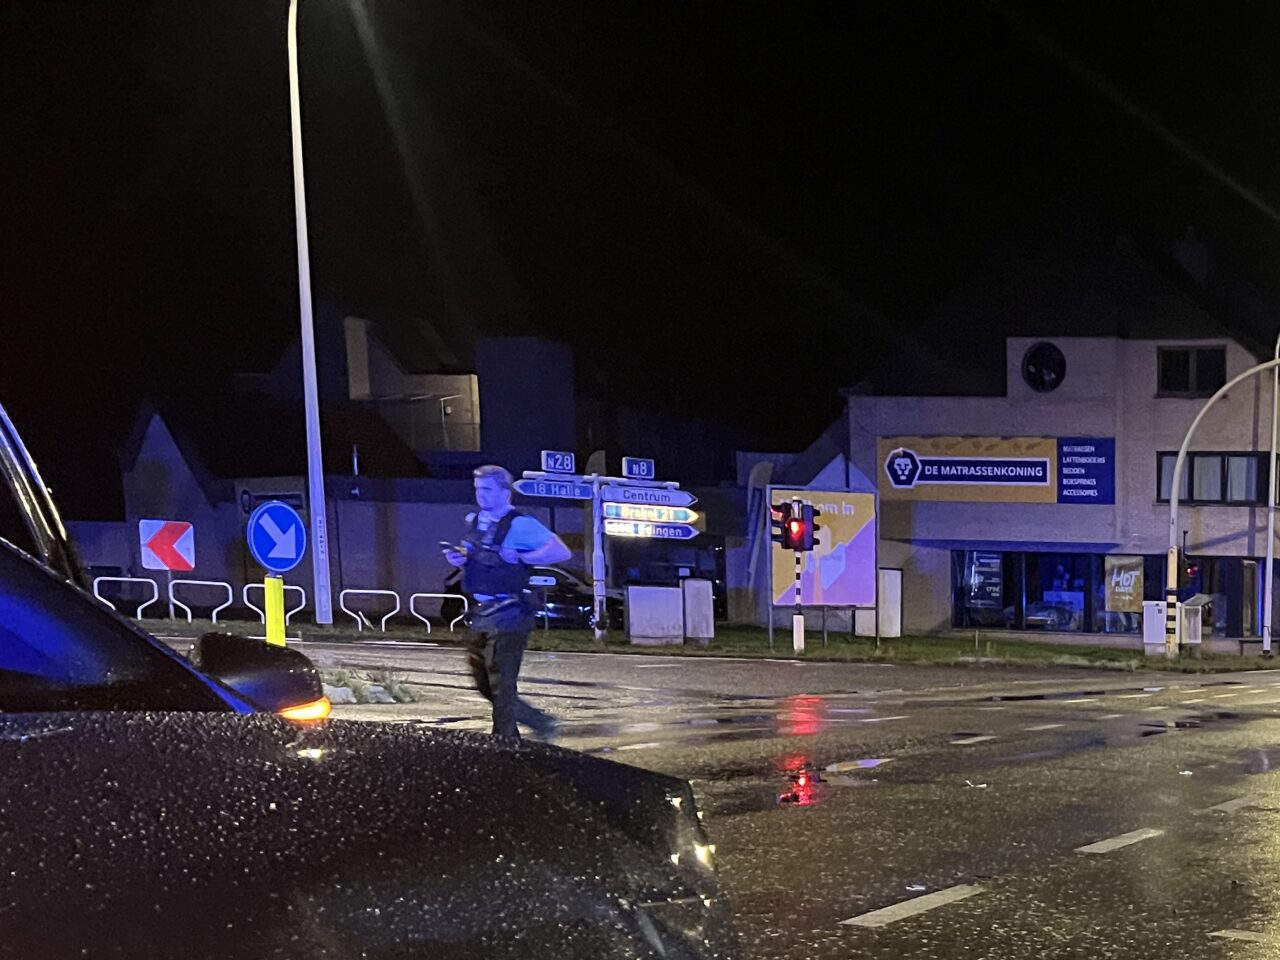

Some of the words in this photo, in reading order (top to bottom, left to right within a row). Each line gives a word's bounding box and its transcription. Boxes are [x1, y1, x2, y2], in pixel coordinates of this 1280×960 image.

[547, 454, 572, 470] N28
[632, 461, 648, 476] N8
[924, 465, 938, 475] DE
[941, 465, 1043, 477] MATRASSENKONING
[533, 483, 546, 494] 18
[551, 484, 581, 496] Halle
[623, 489, 671, 502] Centrum
[1111, 567, 1141, 587] HOT
